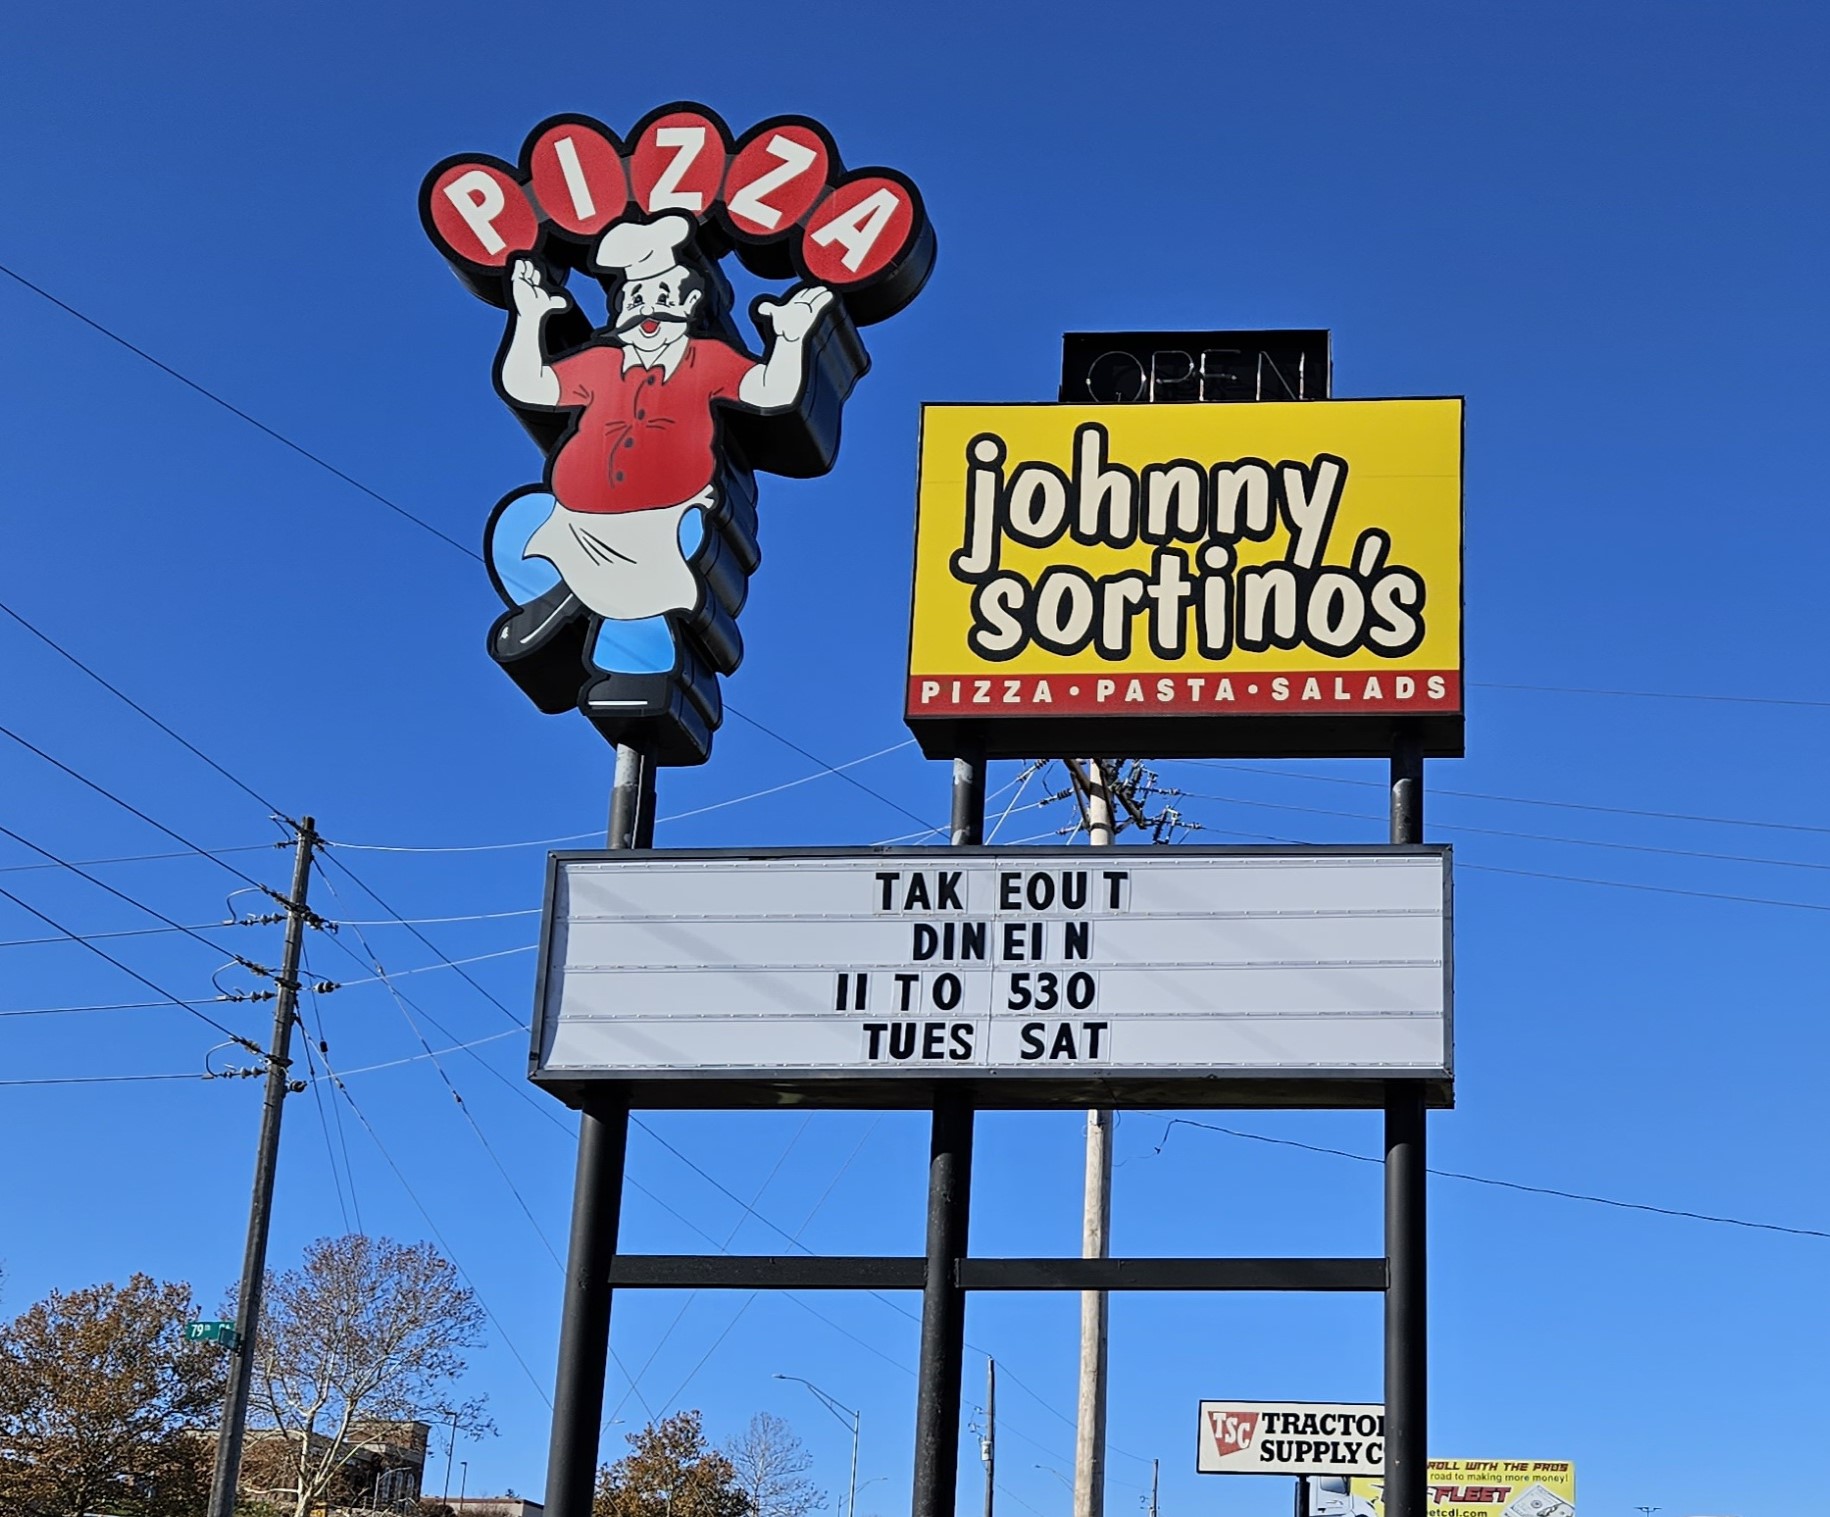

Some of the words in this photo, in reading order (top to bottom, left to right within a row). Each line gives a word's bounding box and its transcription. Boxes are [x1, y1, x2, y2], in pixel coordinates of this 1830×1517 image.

[443, 127, 899, 273] PIZZA
[1086, 349, 1306, 401] OPEN
[952, 424, 1346, 580] johnny
[971, 530, 1422, 657] sortino's
[921, 680, 1052, 703] PIZZA
[1097, 678, 1235, 702] PASTA
[1271, 676, 1446, 701] SALADS
[894, 973, 962, 1011] TO
[1007, 971, 1096, 1010] 530
[862, 1022, 974, 1060] TUES
[1020, 1022, 1108, 1060] SAT
[1213, 1412, 1250, 1449] TSC
[1260, 1439, 1362, 1464] SUPPLY
[1427, 1462, 1460, 1471] ROLL
[1465, 1462, 1498, 1471] WITH
[1503, 1463, 1529, 1472] THE
[1532, 1463, 1569, 1472] PROS
[1430, 1473, 1452, 1481] road
[1455, 1473, 1464, 1481] to
[1467, 1473, 1502, 1483] making
[1532, 1474, 1569, 1484] money!
[1433, 1485, 1512, 1505] FLEET
[1427, 1508, 1488, 1517] etcdl.com
